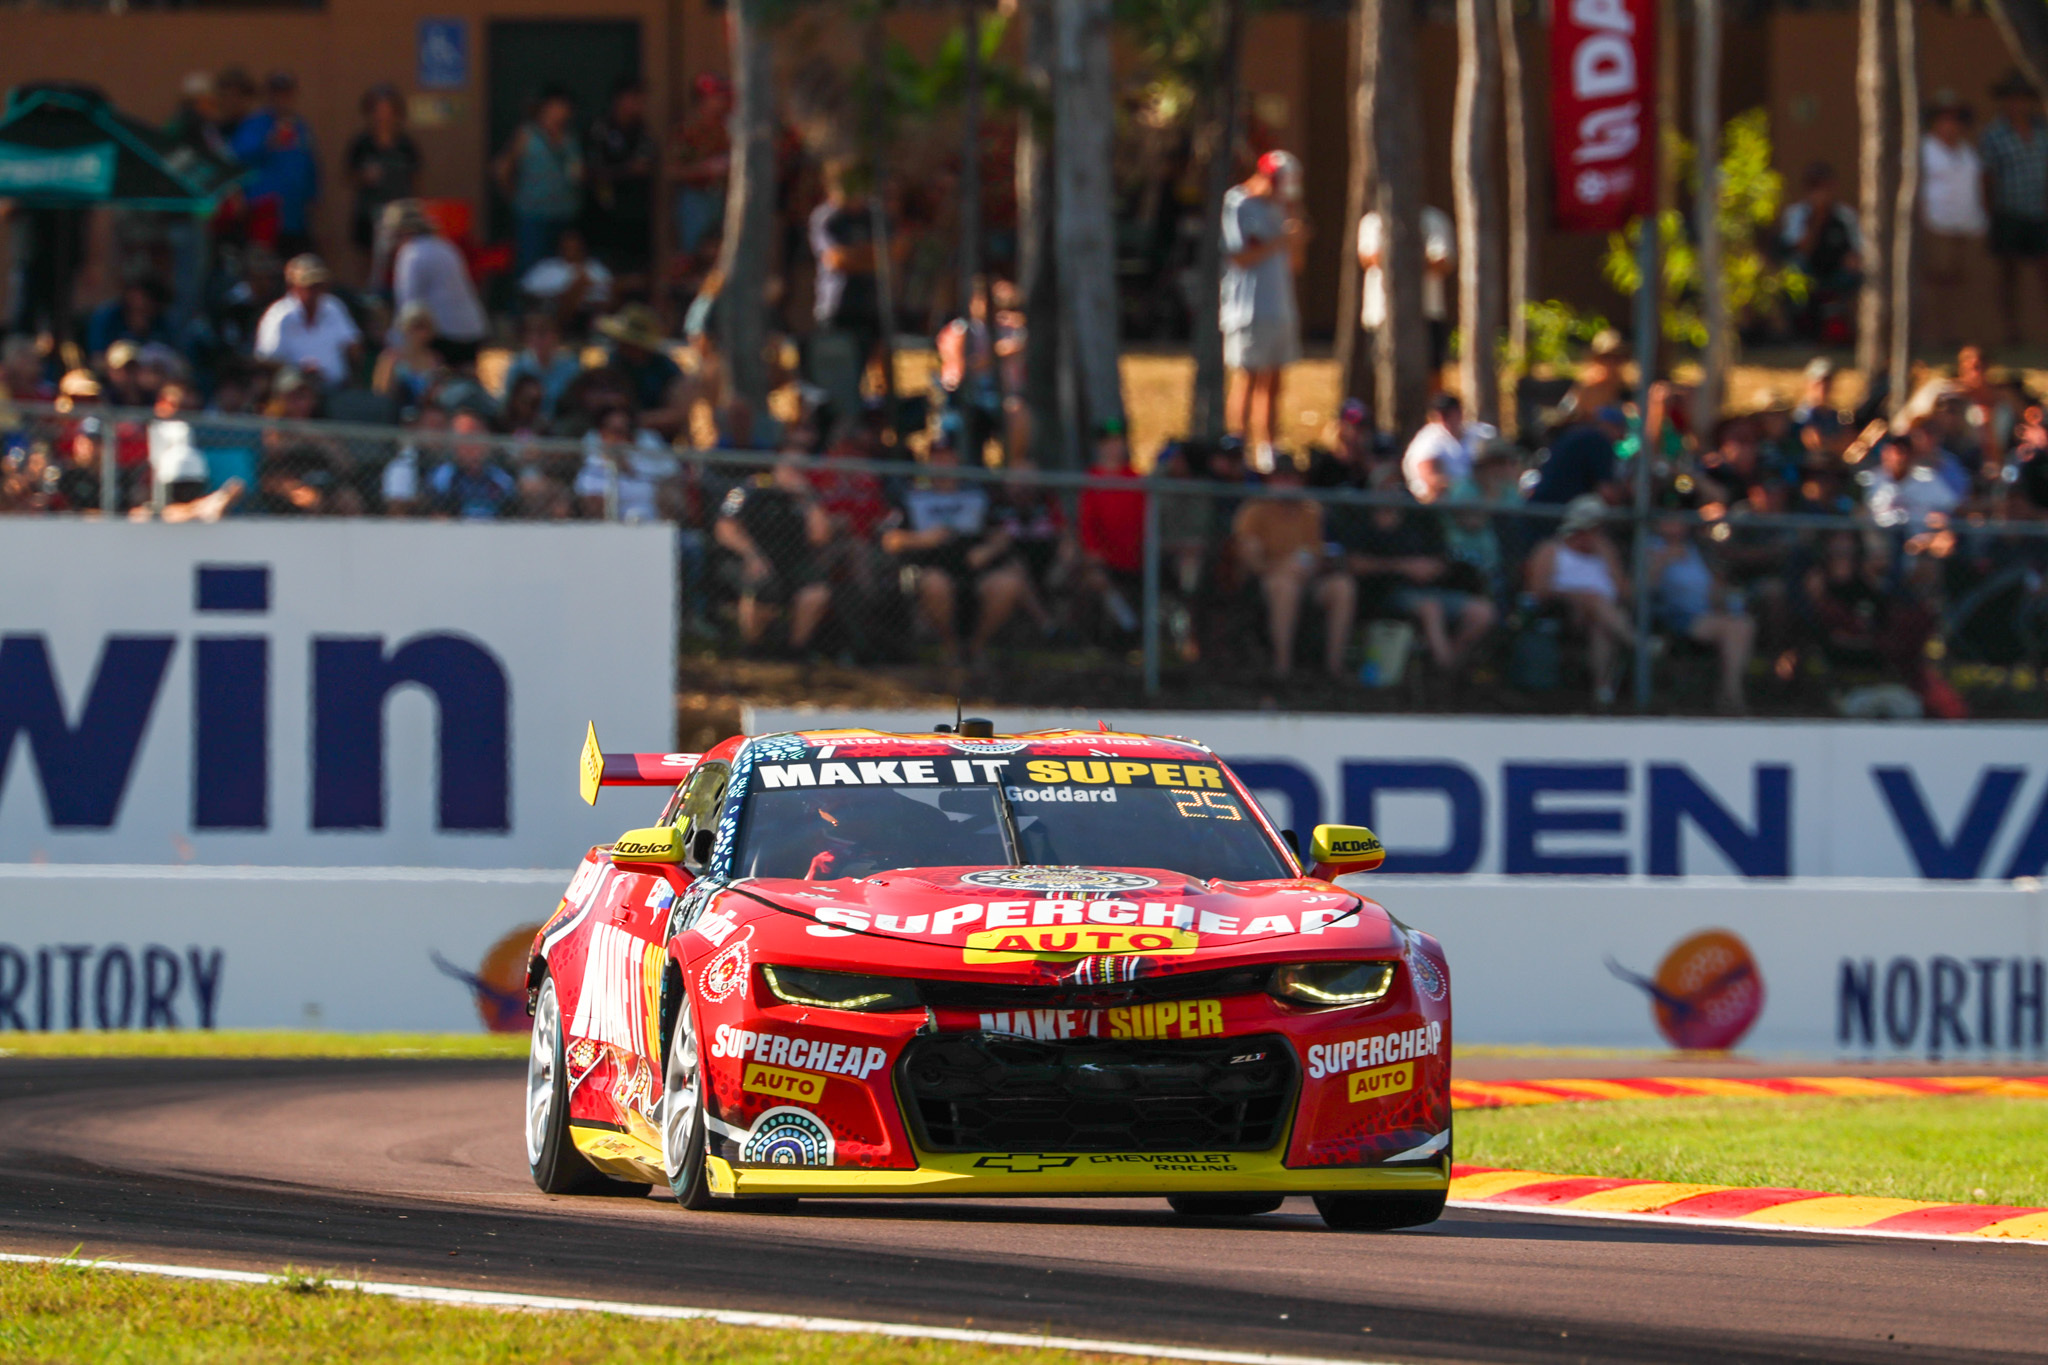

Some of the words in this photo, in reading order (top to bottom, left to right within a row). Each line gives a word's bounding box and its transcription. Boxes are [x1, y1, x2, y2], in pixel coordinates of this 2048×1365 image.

[1103, 738, 1152, 747] last
[759, 760, 939, 788] MAKE
[950, 759, 1011, 783] IT
[1025, 759, 1224, 789] SUPER
[1004, 786, 1118, 802] Goddard
[1170, 789, 1241, 821] 25
[614, 842, 673, 854] ACDelco
[805, 899, 1359, 938] SUPERCHEAP
[987, 931, 1174, 953] AUTO
[1838, 956, 2046, 1048] NORTH
[979, 1009, 1076, 1041] MAKE
[1108, 999, 1224, 1040] SUPER
[711, 1023, 887, 1080] SUPERCHEAP
[1308, 1021, 1442, 1080] SUPERCHEAP
[751, 1071, 815, 1096] AUTO
[1355, 1069, 1407, 1095] AUTO
[1088, 1153, 1232, 1164] CHEVROLET
[1154, 1164, 1238, 1172] RACING
